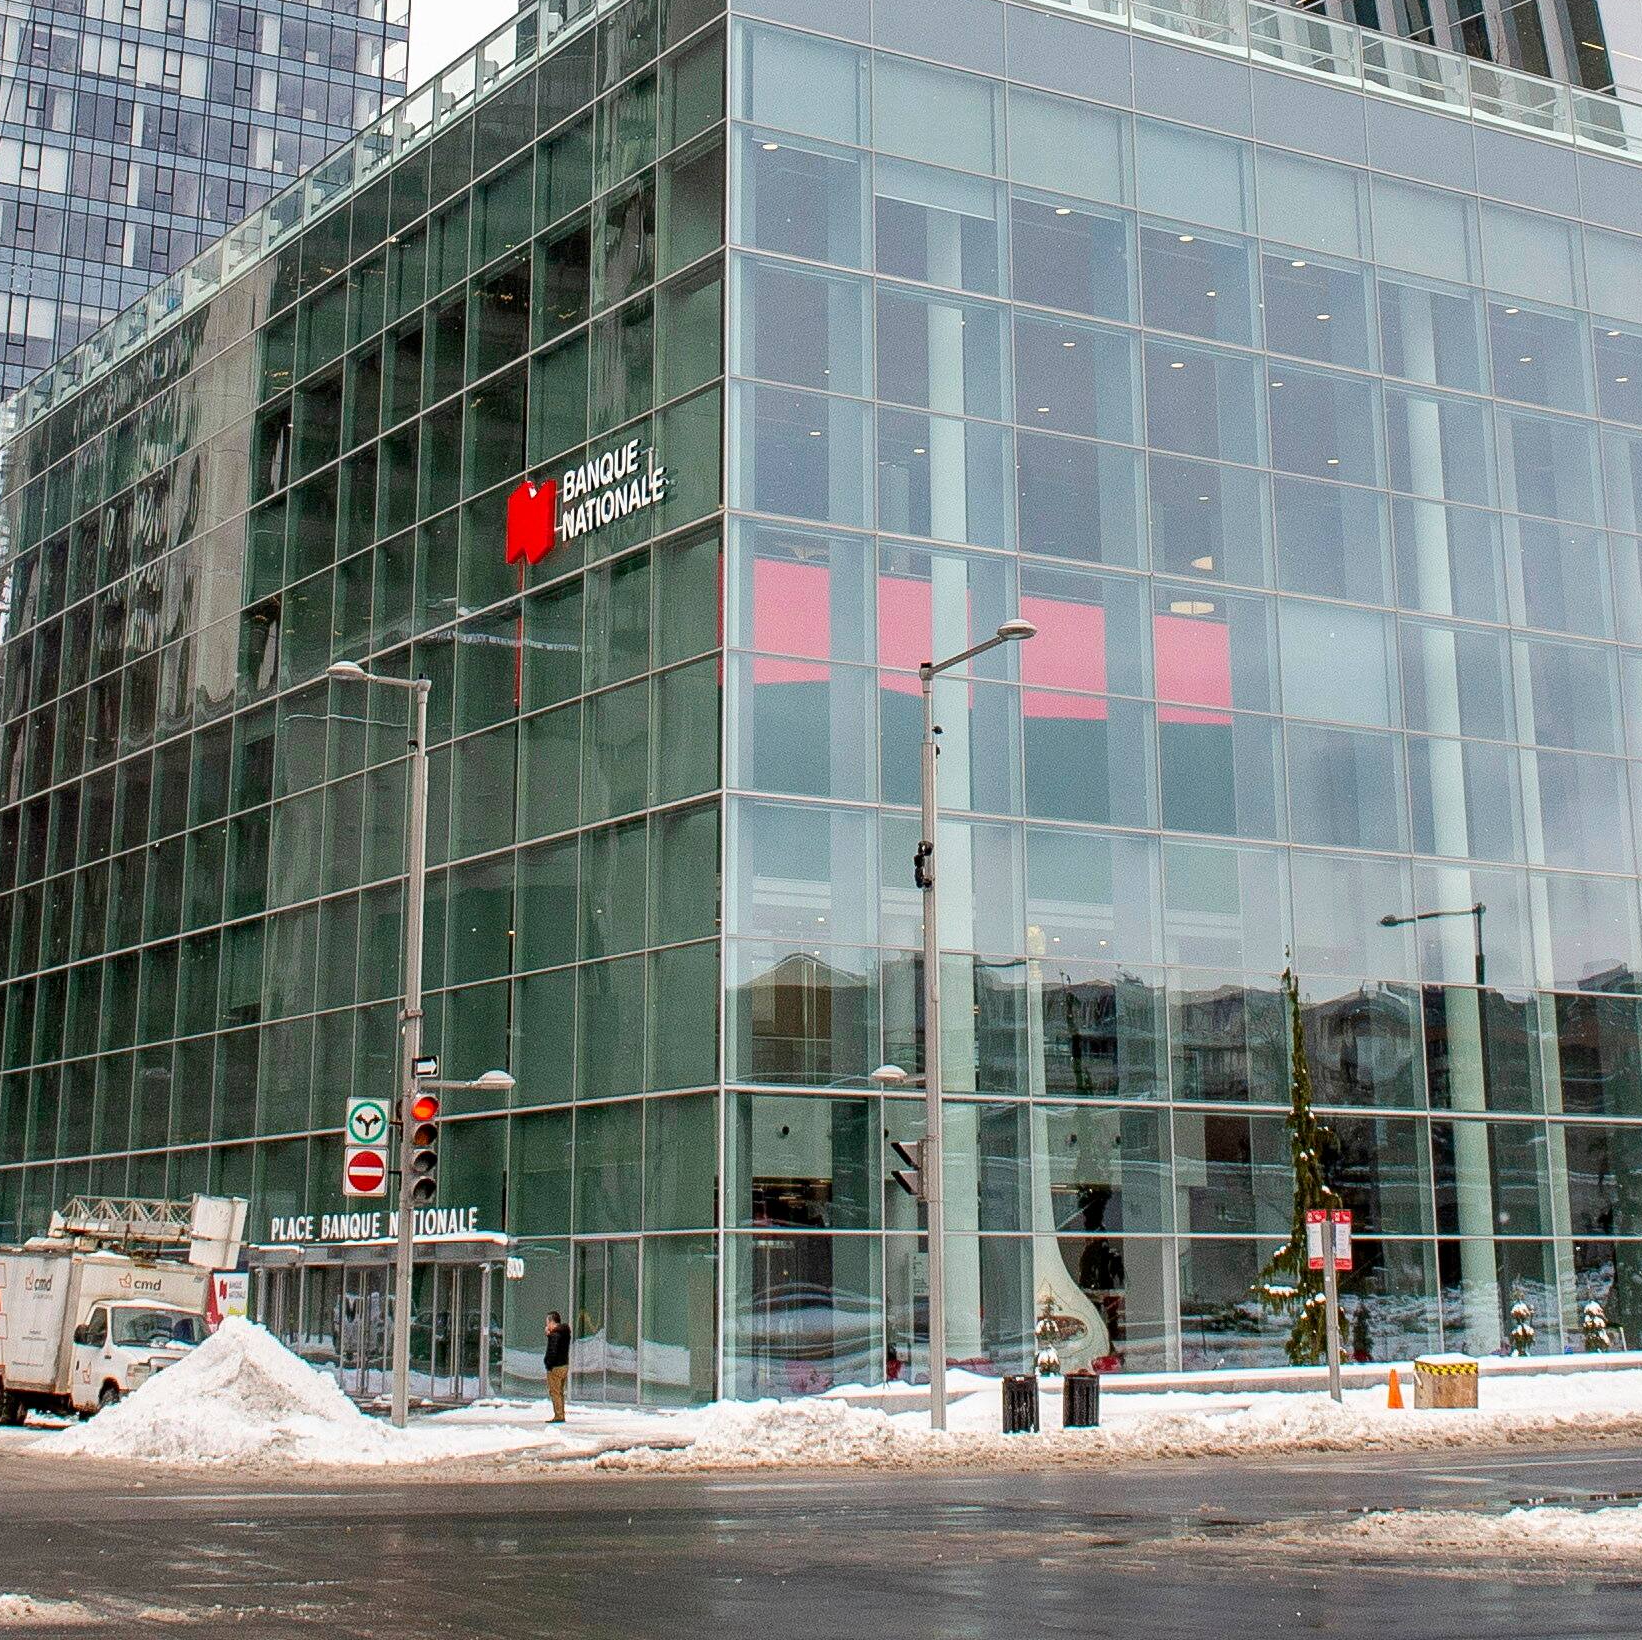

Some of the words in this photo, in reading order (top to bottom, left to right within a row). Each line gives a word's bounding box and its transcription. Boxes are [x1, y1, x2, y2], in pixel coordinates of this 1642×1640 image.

[562, 438, 641, 502] BANQUE
[562, 467, 666, 541] NATIONALE
[271, 1215, 314, 1241] PLACE
[320, 1211, 381, 1240] BANQUE
[388, 1206, 478, 1237] NTIONALE
[34, 1274, 53, 1291] cmd
[134, 1279, 162, 1291] cmd
